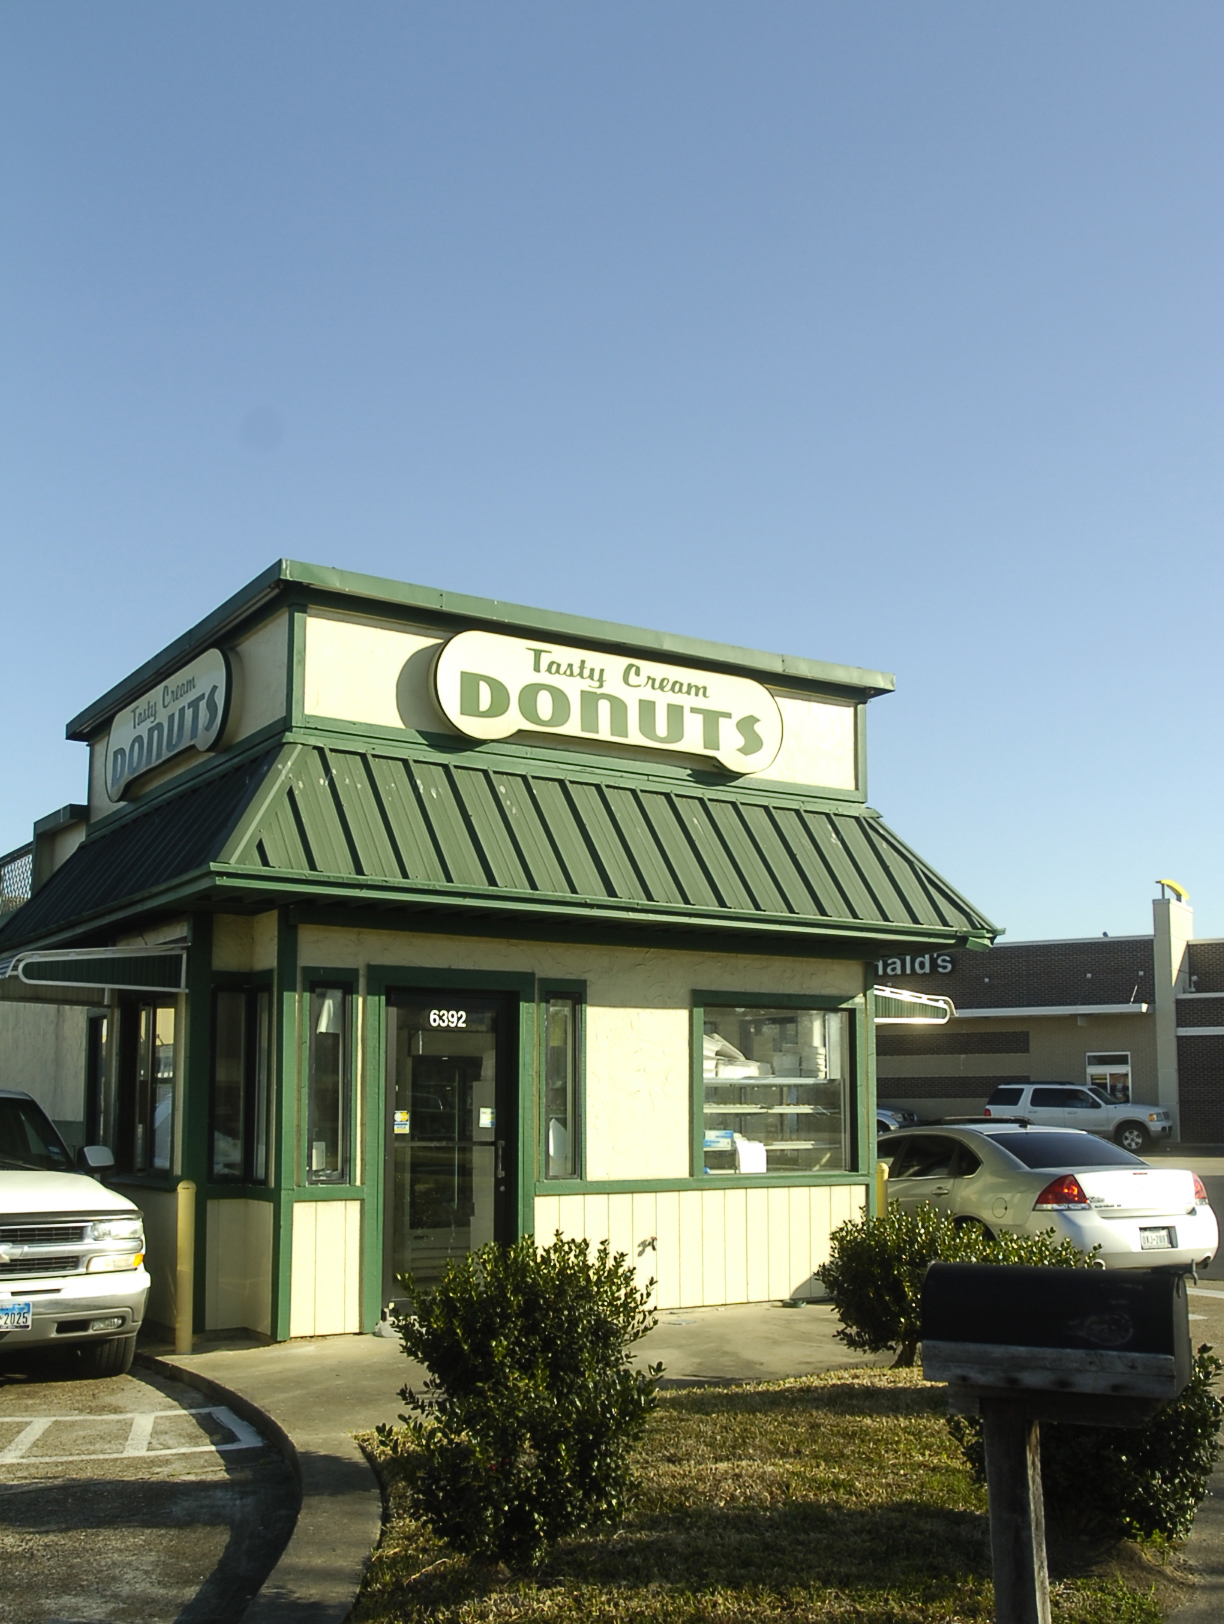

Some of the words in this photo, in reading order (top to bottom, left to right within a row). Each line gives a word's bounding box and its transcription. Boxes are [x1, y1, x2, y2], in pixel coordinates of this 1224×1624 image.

[525, 647, 606, 689] Tasty
[622, 663, 710, 698] Cream
[131, 701, 157, 729] Tasty
[162, 676, 196, 709] Cream
[460, 671, 764, 756] DONUTS
[111, 684, 219, 788] DONUTS
[429, 1009, 467, 1028] 6392
[4, 1312, 28, 1325] 2025
